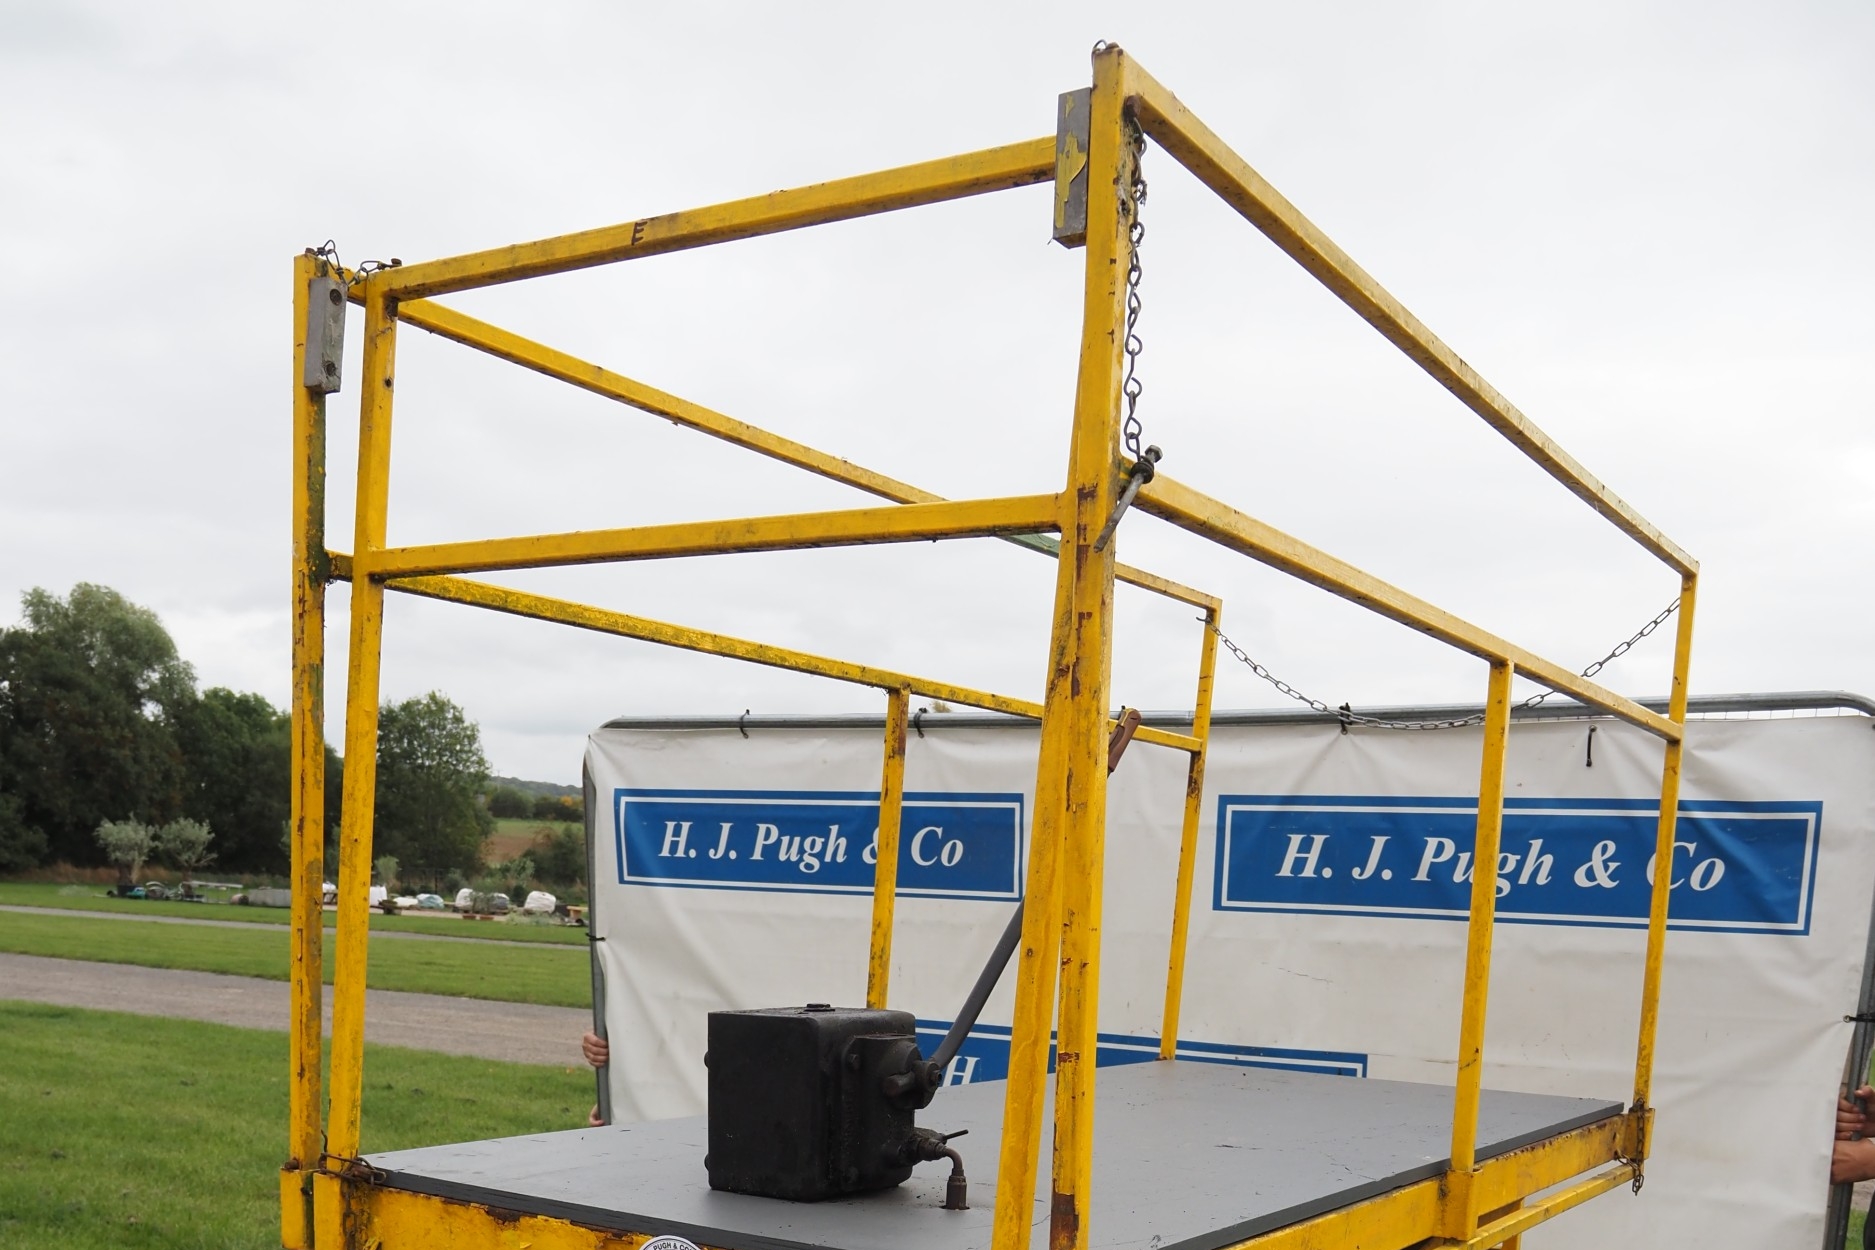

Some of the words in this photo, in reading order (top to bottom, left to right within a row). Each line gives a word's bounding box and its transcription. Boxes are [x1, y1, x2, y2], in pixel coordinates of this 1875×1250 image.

[658, 821, 697, 859] H.
[708, 822, 737, 860] J.
[749, 823, 848, 873] Pugh
[911, 826, 964, 867] Co
[1274, 834, 1333, 879] H.
[1351, 835, 1393, 881] J.
[1410, 836, 1554, 898] Pugh
[1573, 839, 1622, 889] &
[1646, 841, 1726, 892] Co
[672, 1242, 678, 1250] &
